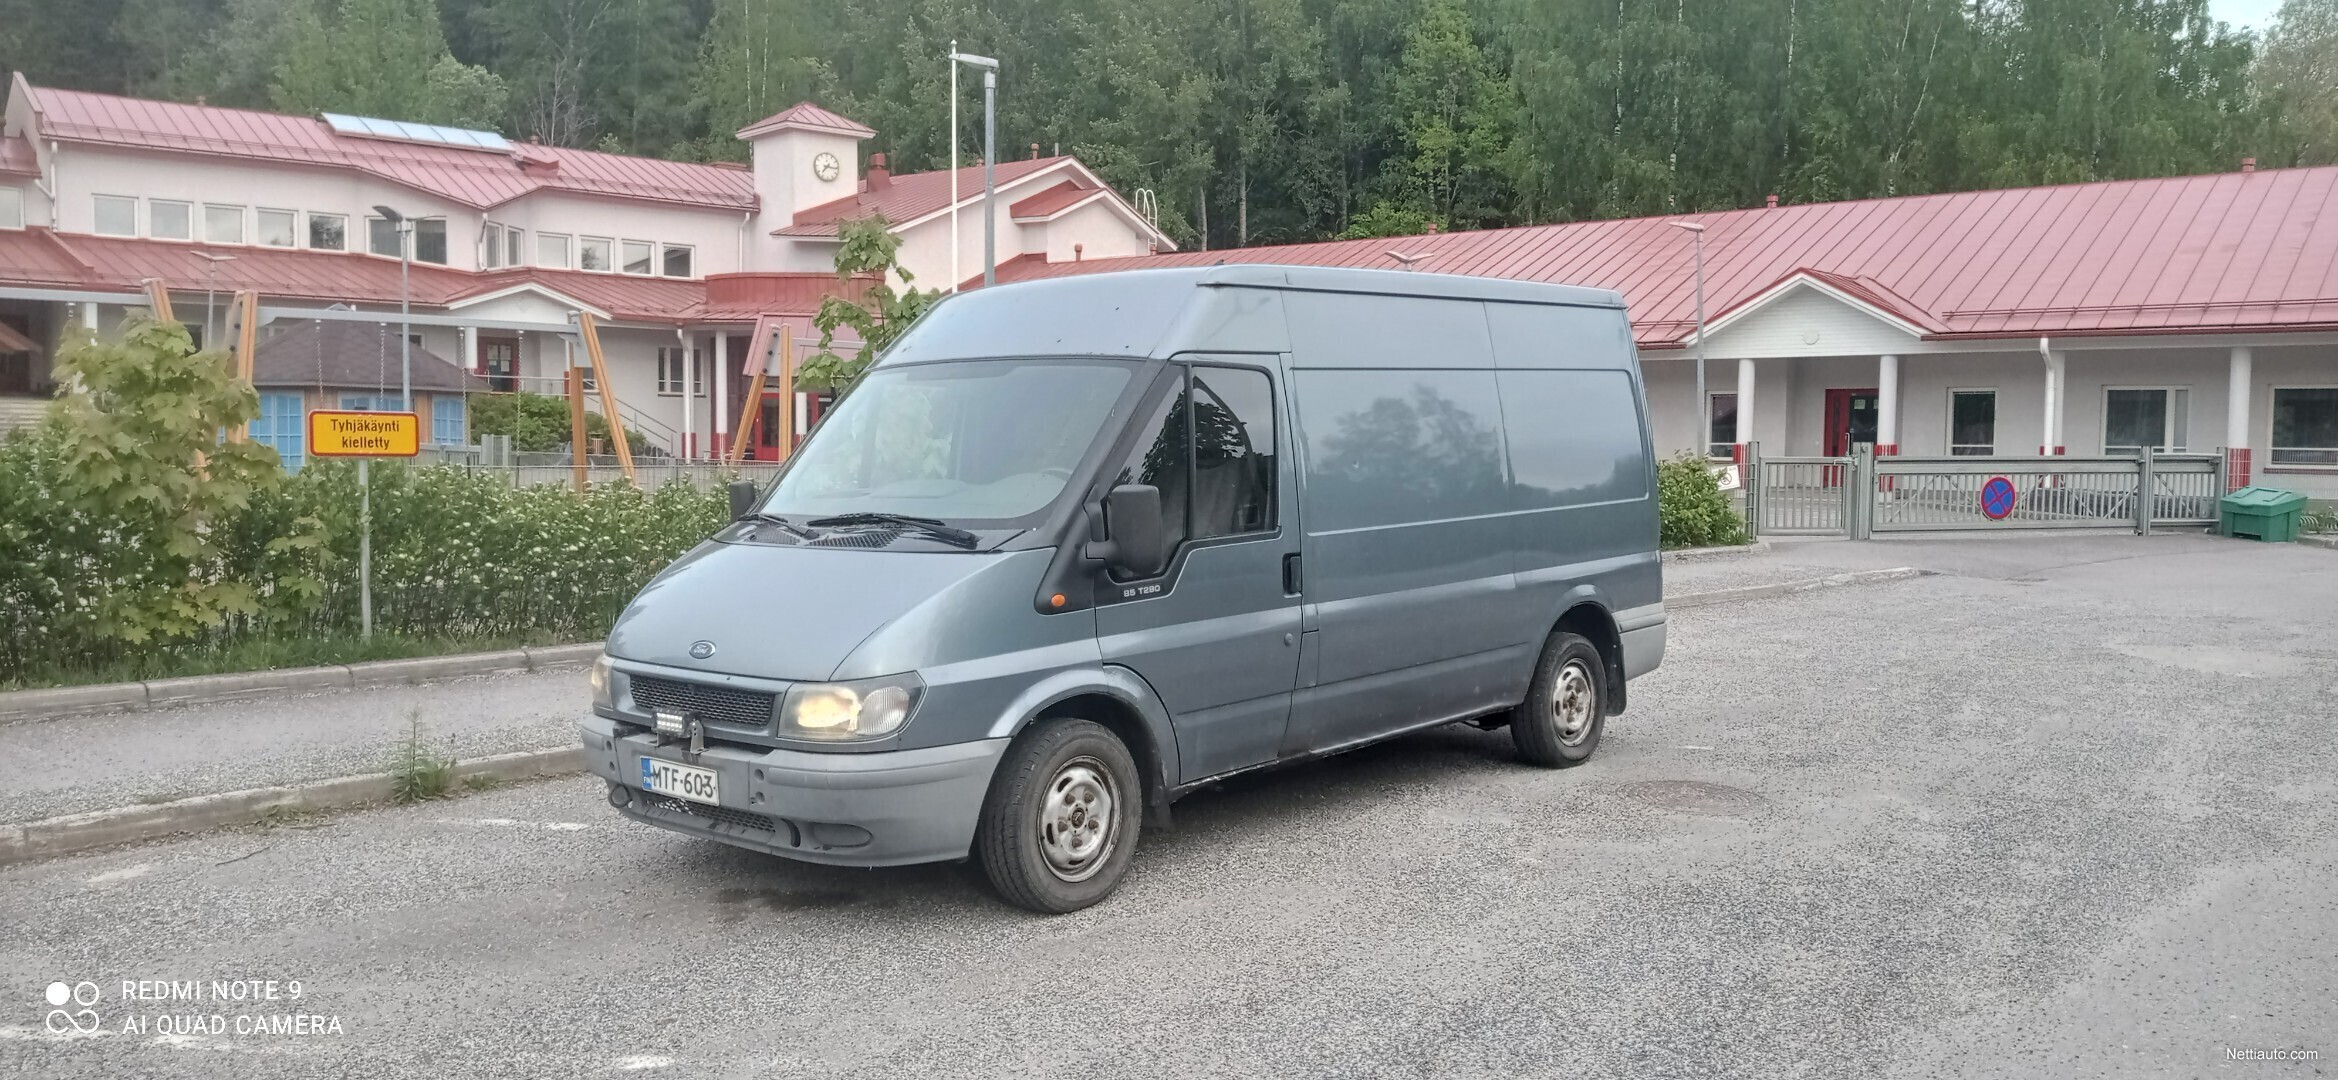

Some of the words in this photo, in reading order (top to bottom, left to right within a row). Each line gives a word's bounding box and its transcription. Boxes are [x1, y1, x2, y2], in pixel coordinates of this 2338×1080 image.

[330, 418, 400, 434] Tyhjäkäynti
[341, 436, 390, 450] kielletty
[652, 764, 714, 798] MTF-603
